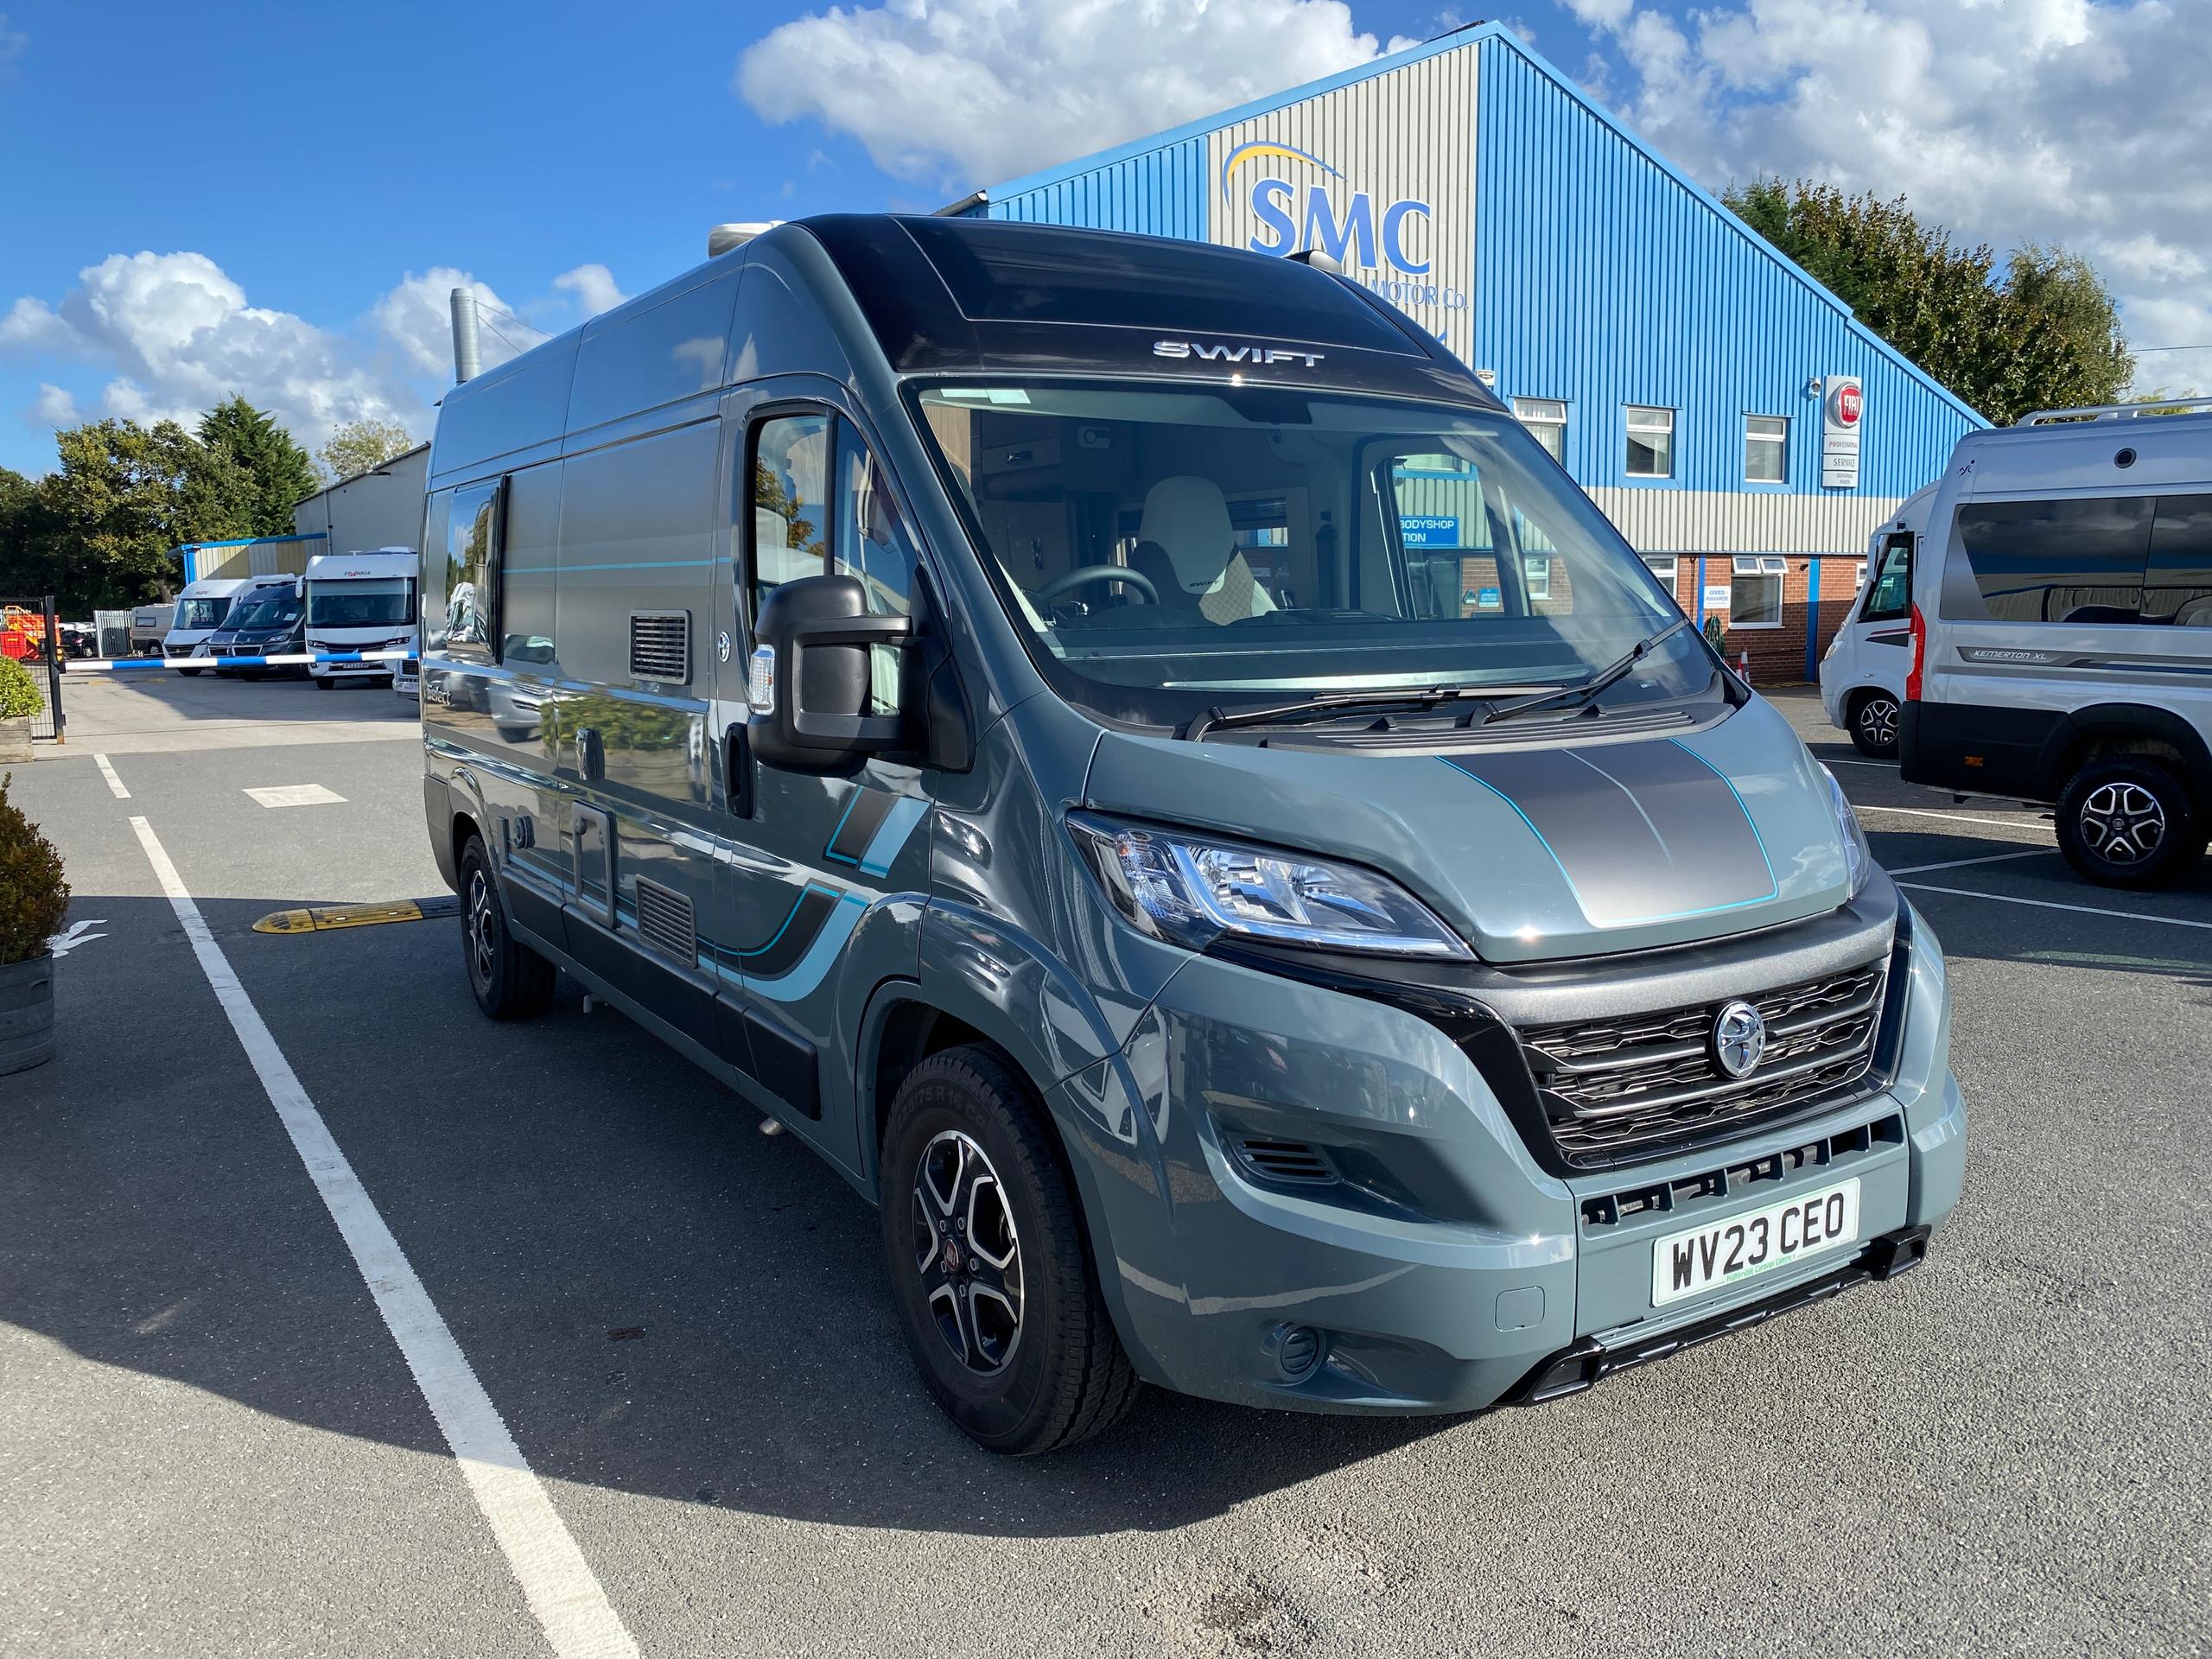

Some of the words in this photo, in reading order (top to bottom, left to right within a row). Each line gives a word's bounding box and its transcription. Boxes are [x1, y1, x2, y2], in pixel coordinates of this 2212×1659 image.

[1249, 176, 1432, 276] SMC
[1370, 279, 1438, 306] MOTOR
[1153, 341, 1325, 367] SWIFT
[1843, 394, 1860, 416] FIAT
[1834, 458, 1855, 467] SERVICE
[1400, 519, 1454, 530] BODYSHOP
[1974, 650, 2030, 659] KEMERTON
[1672, 1217, 1769, 1292] WV23
[1780, 1192, 1845, 1254] CEO
